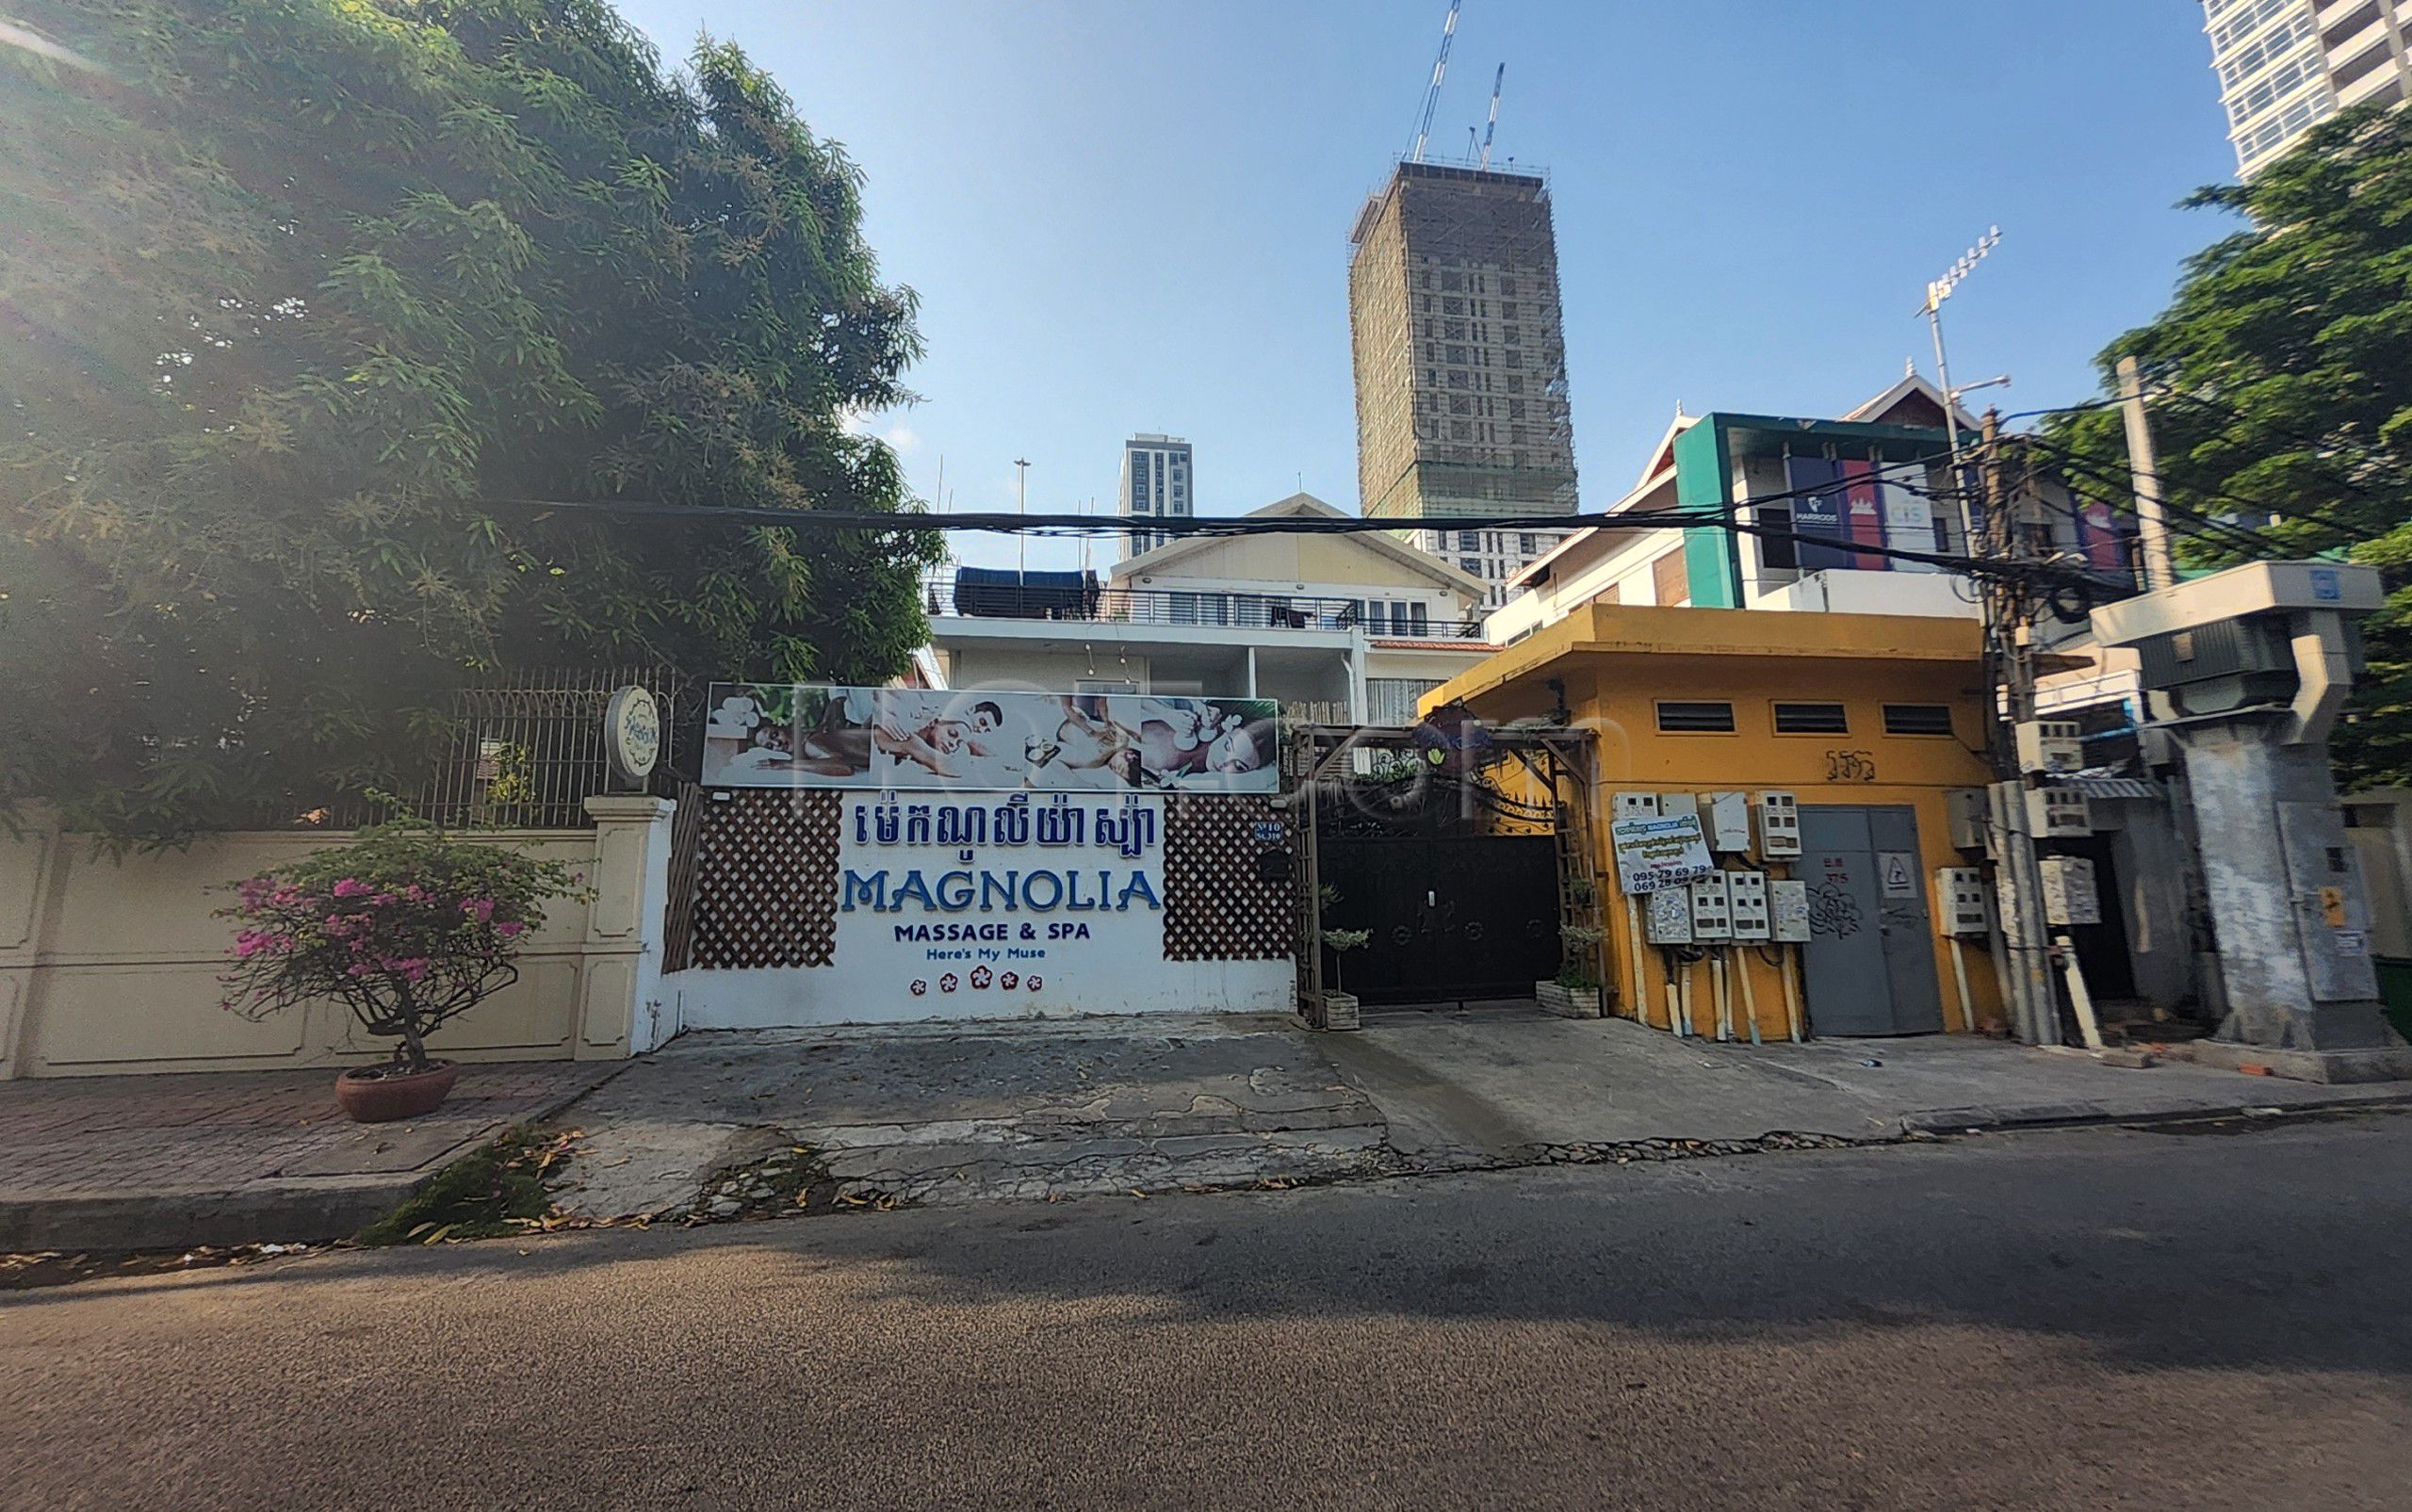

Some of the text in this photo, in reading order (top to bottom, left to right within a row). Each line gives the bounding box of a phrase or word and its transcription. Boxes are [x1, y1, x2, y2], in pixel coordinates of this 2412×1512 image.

[1633, 871, 1654, 882] 095
[1658, 870, 1672, 879] 79
[1675, 867, 1689, 877] 69
[1691, 865, 1706, 875] 79
[840, 870, 1162, 912] MAGNOLIA
[1634, 881, 1655, 892] 069
[1658, 878, 1671, 888] 28
[894, 921, 1091, 942] MASSAGE & SPA
[926, 947, 1046, 962] Here's My Muse
